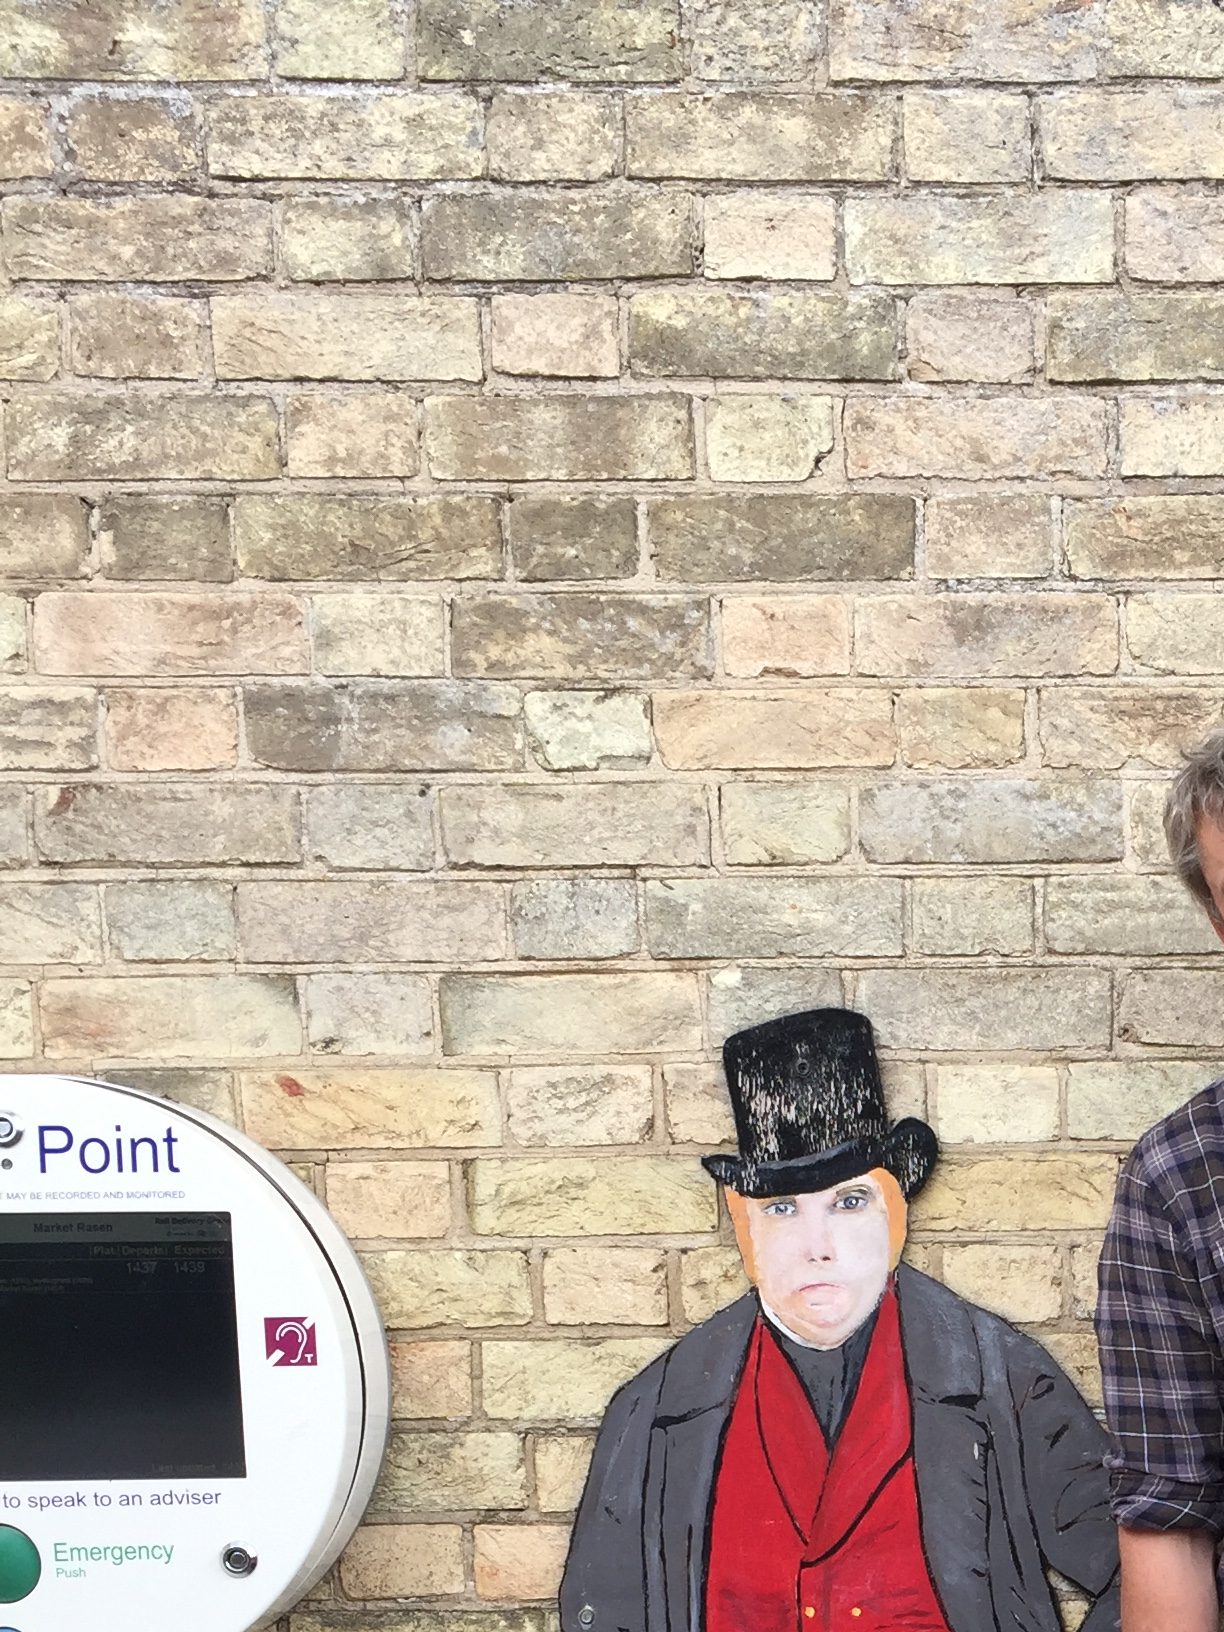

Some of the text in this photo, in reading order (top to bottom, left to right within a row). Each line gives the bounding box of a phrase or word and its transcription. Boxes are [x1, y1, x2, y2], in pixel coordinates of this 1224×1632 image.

[37, 1125, 181, 1174] Point
[6, 1192, 27, 1200] MAY
[30, 1192, 42, 1200] BE
[45, 1191, 100, 1200] RECORDED
[103, 1191, 123, 1199] AND
[126, 1191, 186, 1199] MONITORED
[33, 1222, 113, 1233] Market Rasen
[2, 1490, 222, 1511] to speak to an adviser
[53, 1542, 174, 1565] Emergency
[56, 1567, 87, 1578] Push
